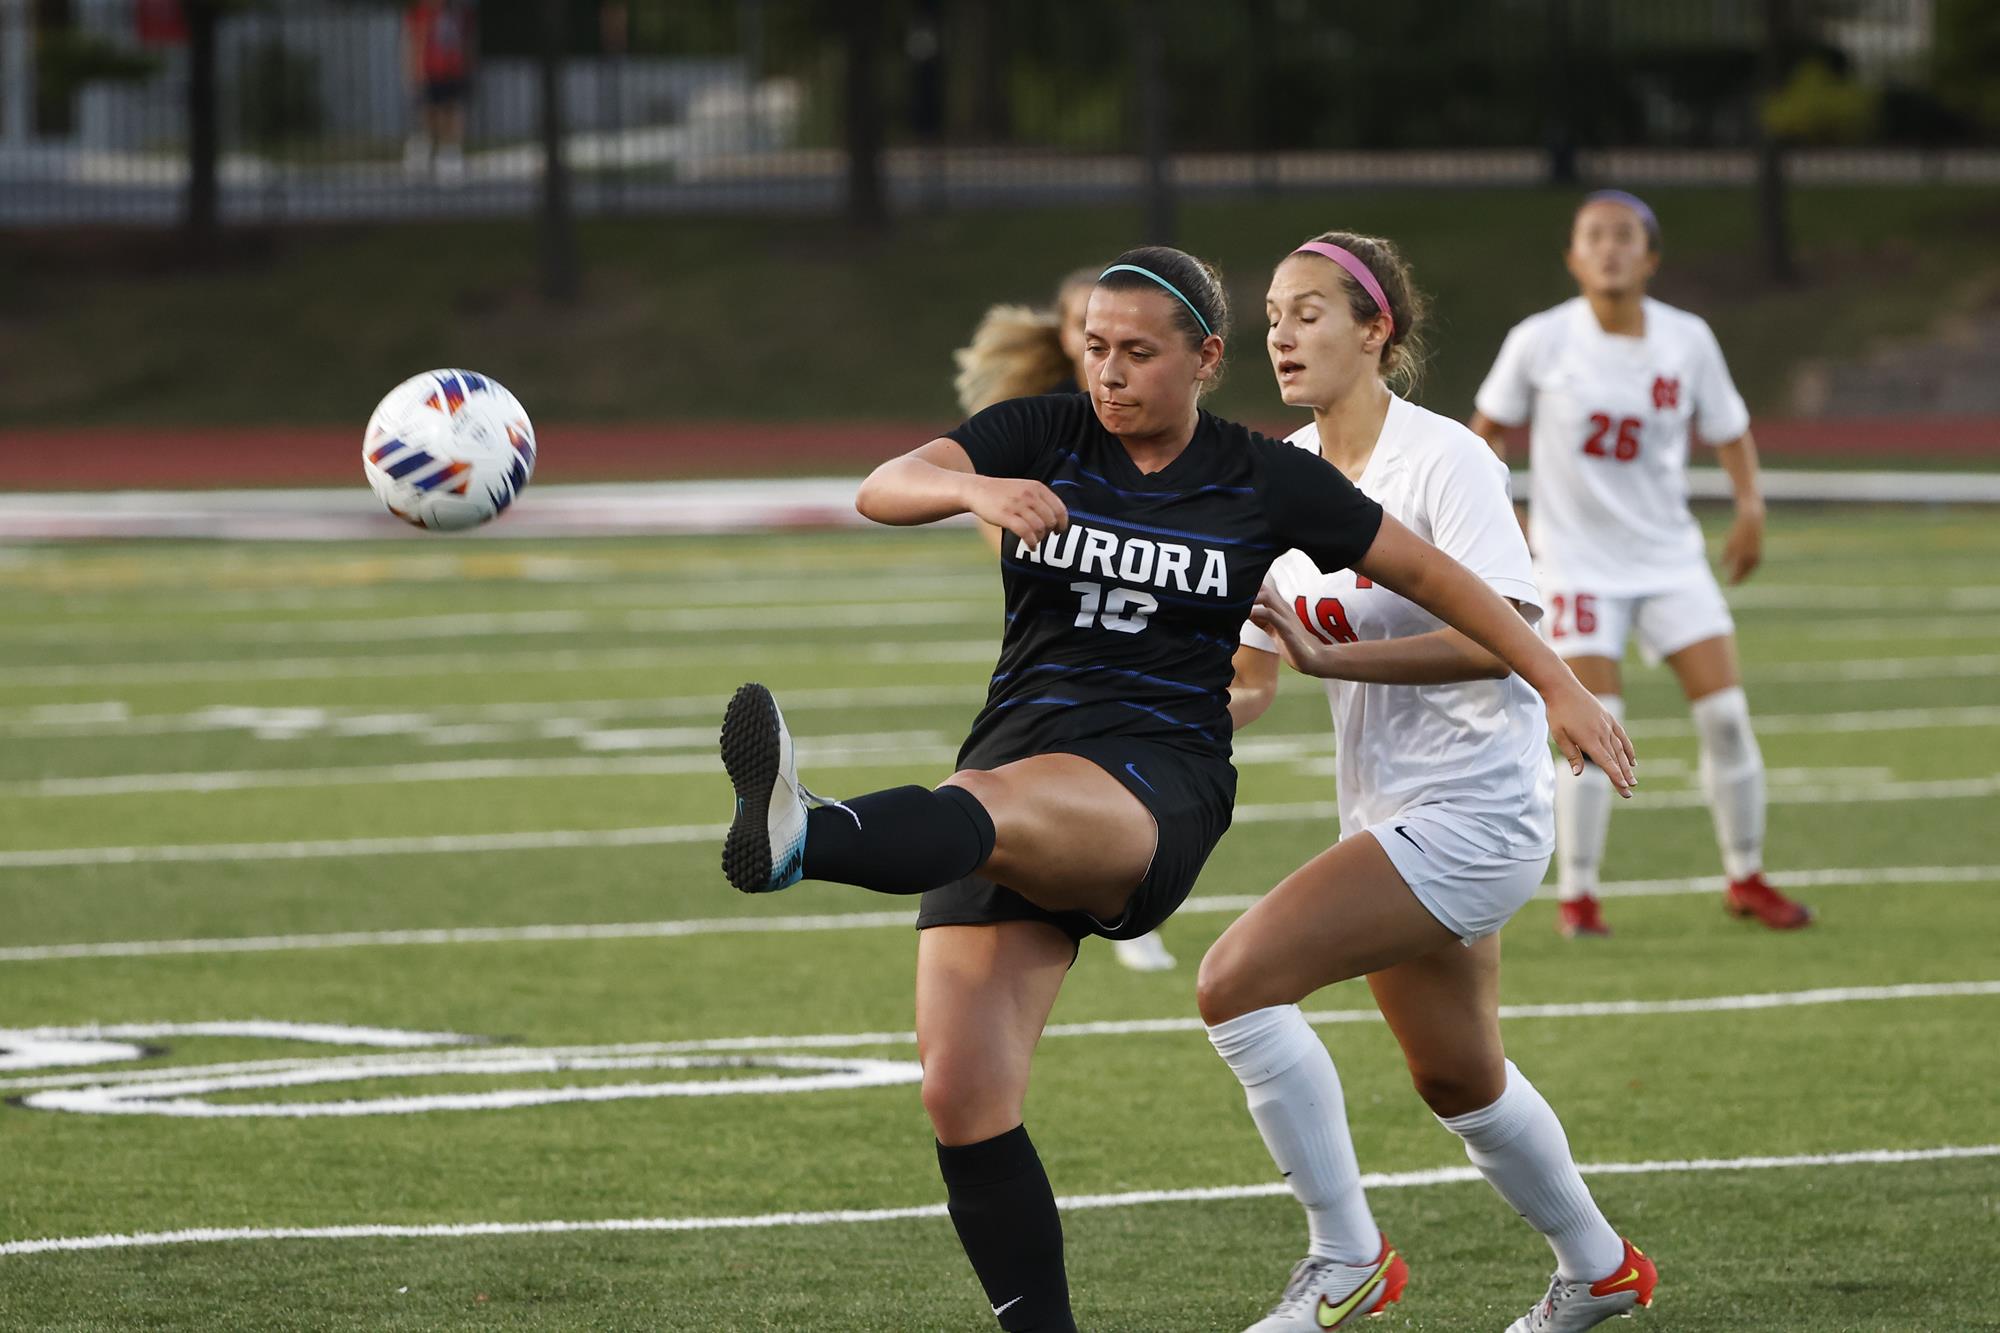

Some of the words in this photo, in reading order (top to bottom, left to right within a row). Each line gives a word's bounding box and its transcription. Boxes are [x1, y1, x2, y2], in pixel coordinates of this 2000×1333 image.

[1583, 410, 1642, 462] 26
[1070, 581, 1159, 634] 10
[1551, 593, 1598, 639] 26
